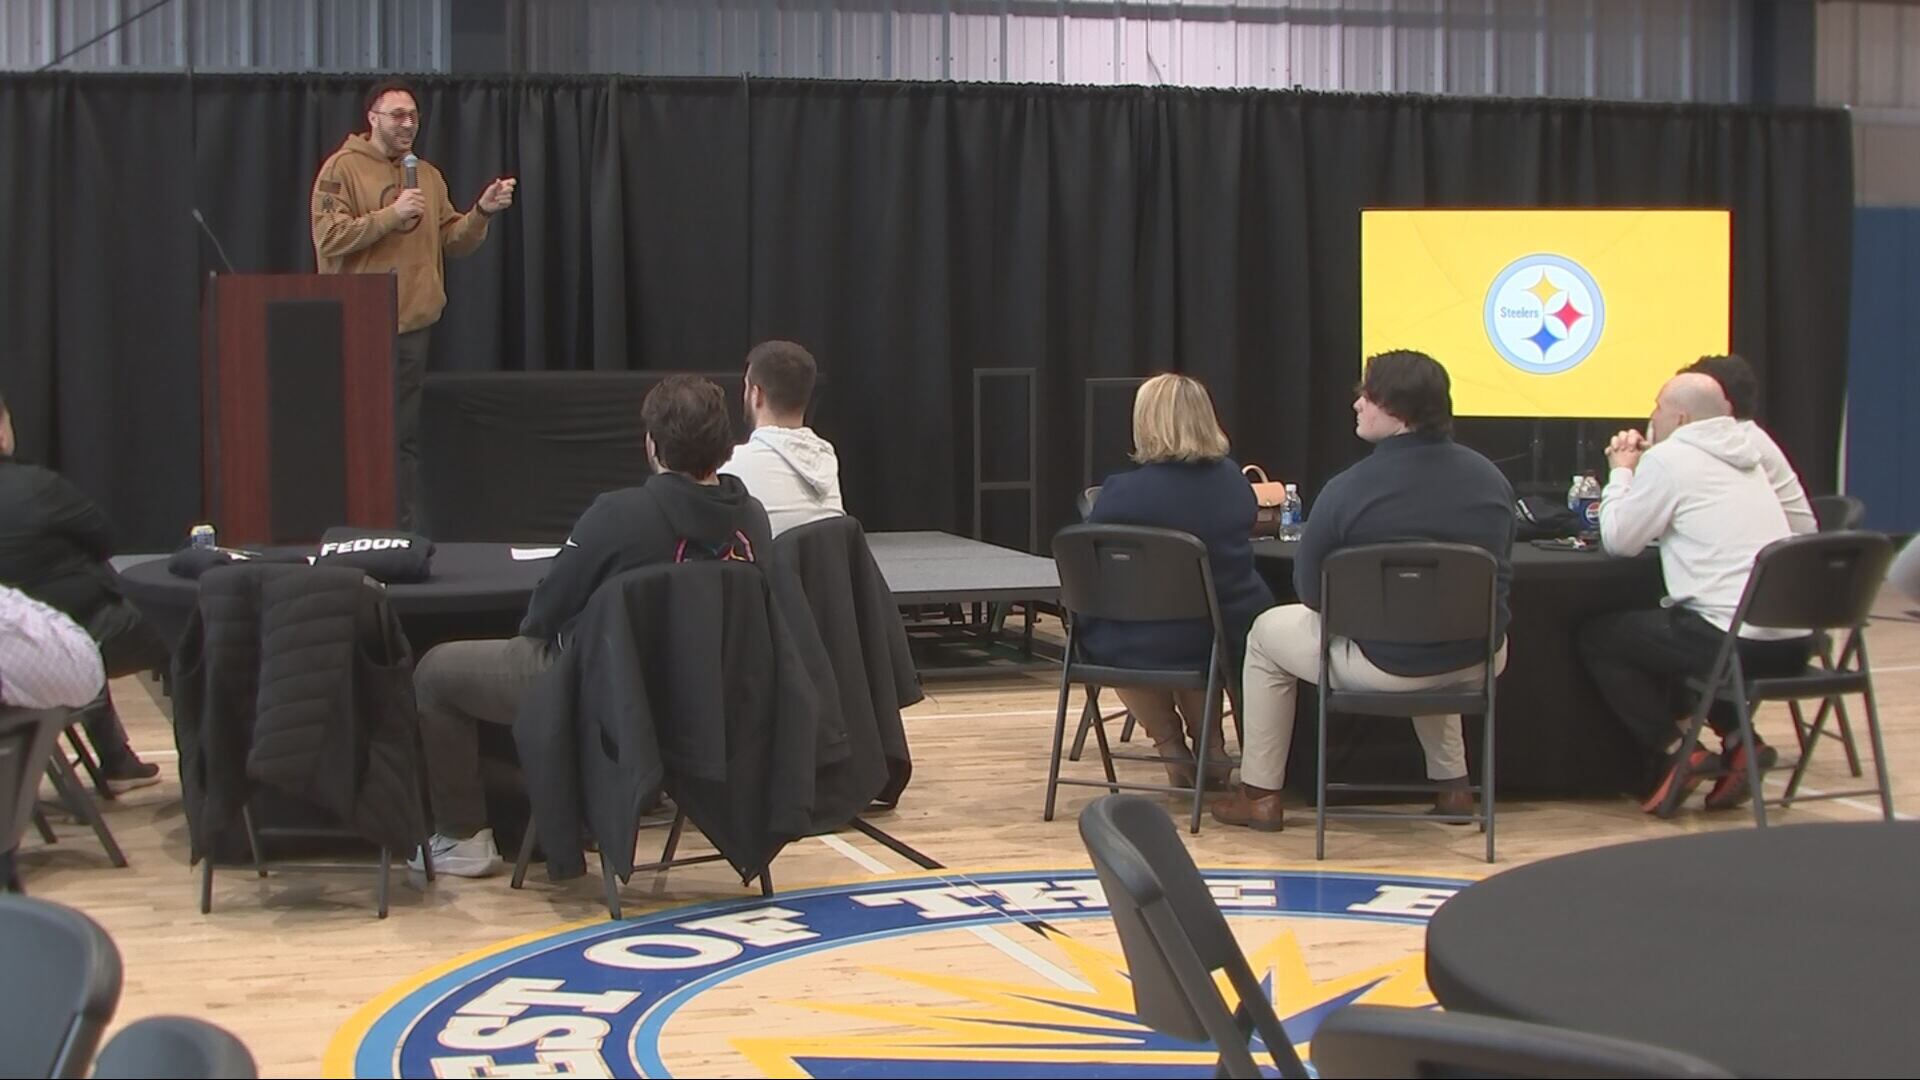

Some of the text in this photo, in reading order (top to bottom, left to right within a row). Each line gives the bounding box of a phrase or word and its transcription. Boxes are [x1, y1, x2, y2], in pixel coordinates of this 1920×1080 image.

[1499, 306, 1539, 319] Steelers
[320, 538, 411, 557] FEDOR
[582, 906, 822, 970] OF
[848, 879, 1277, 920] THE
